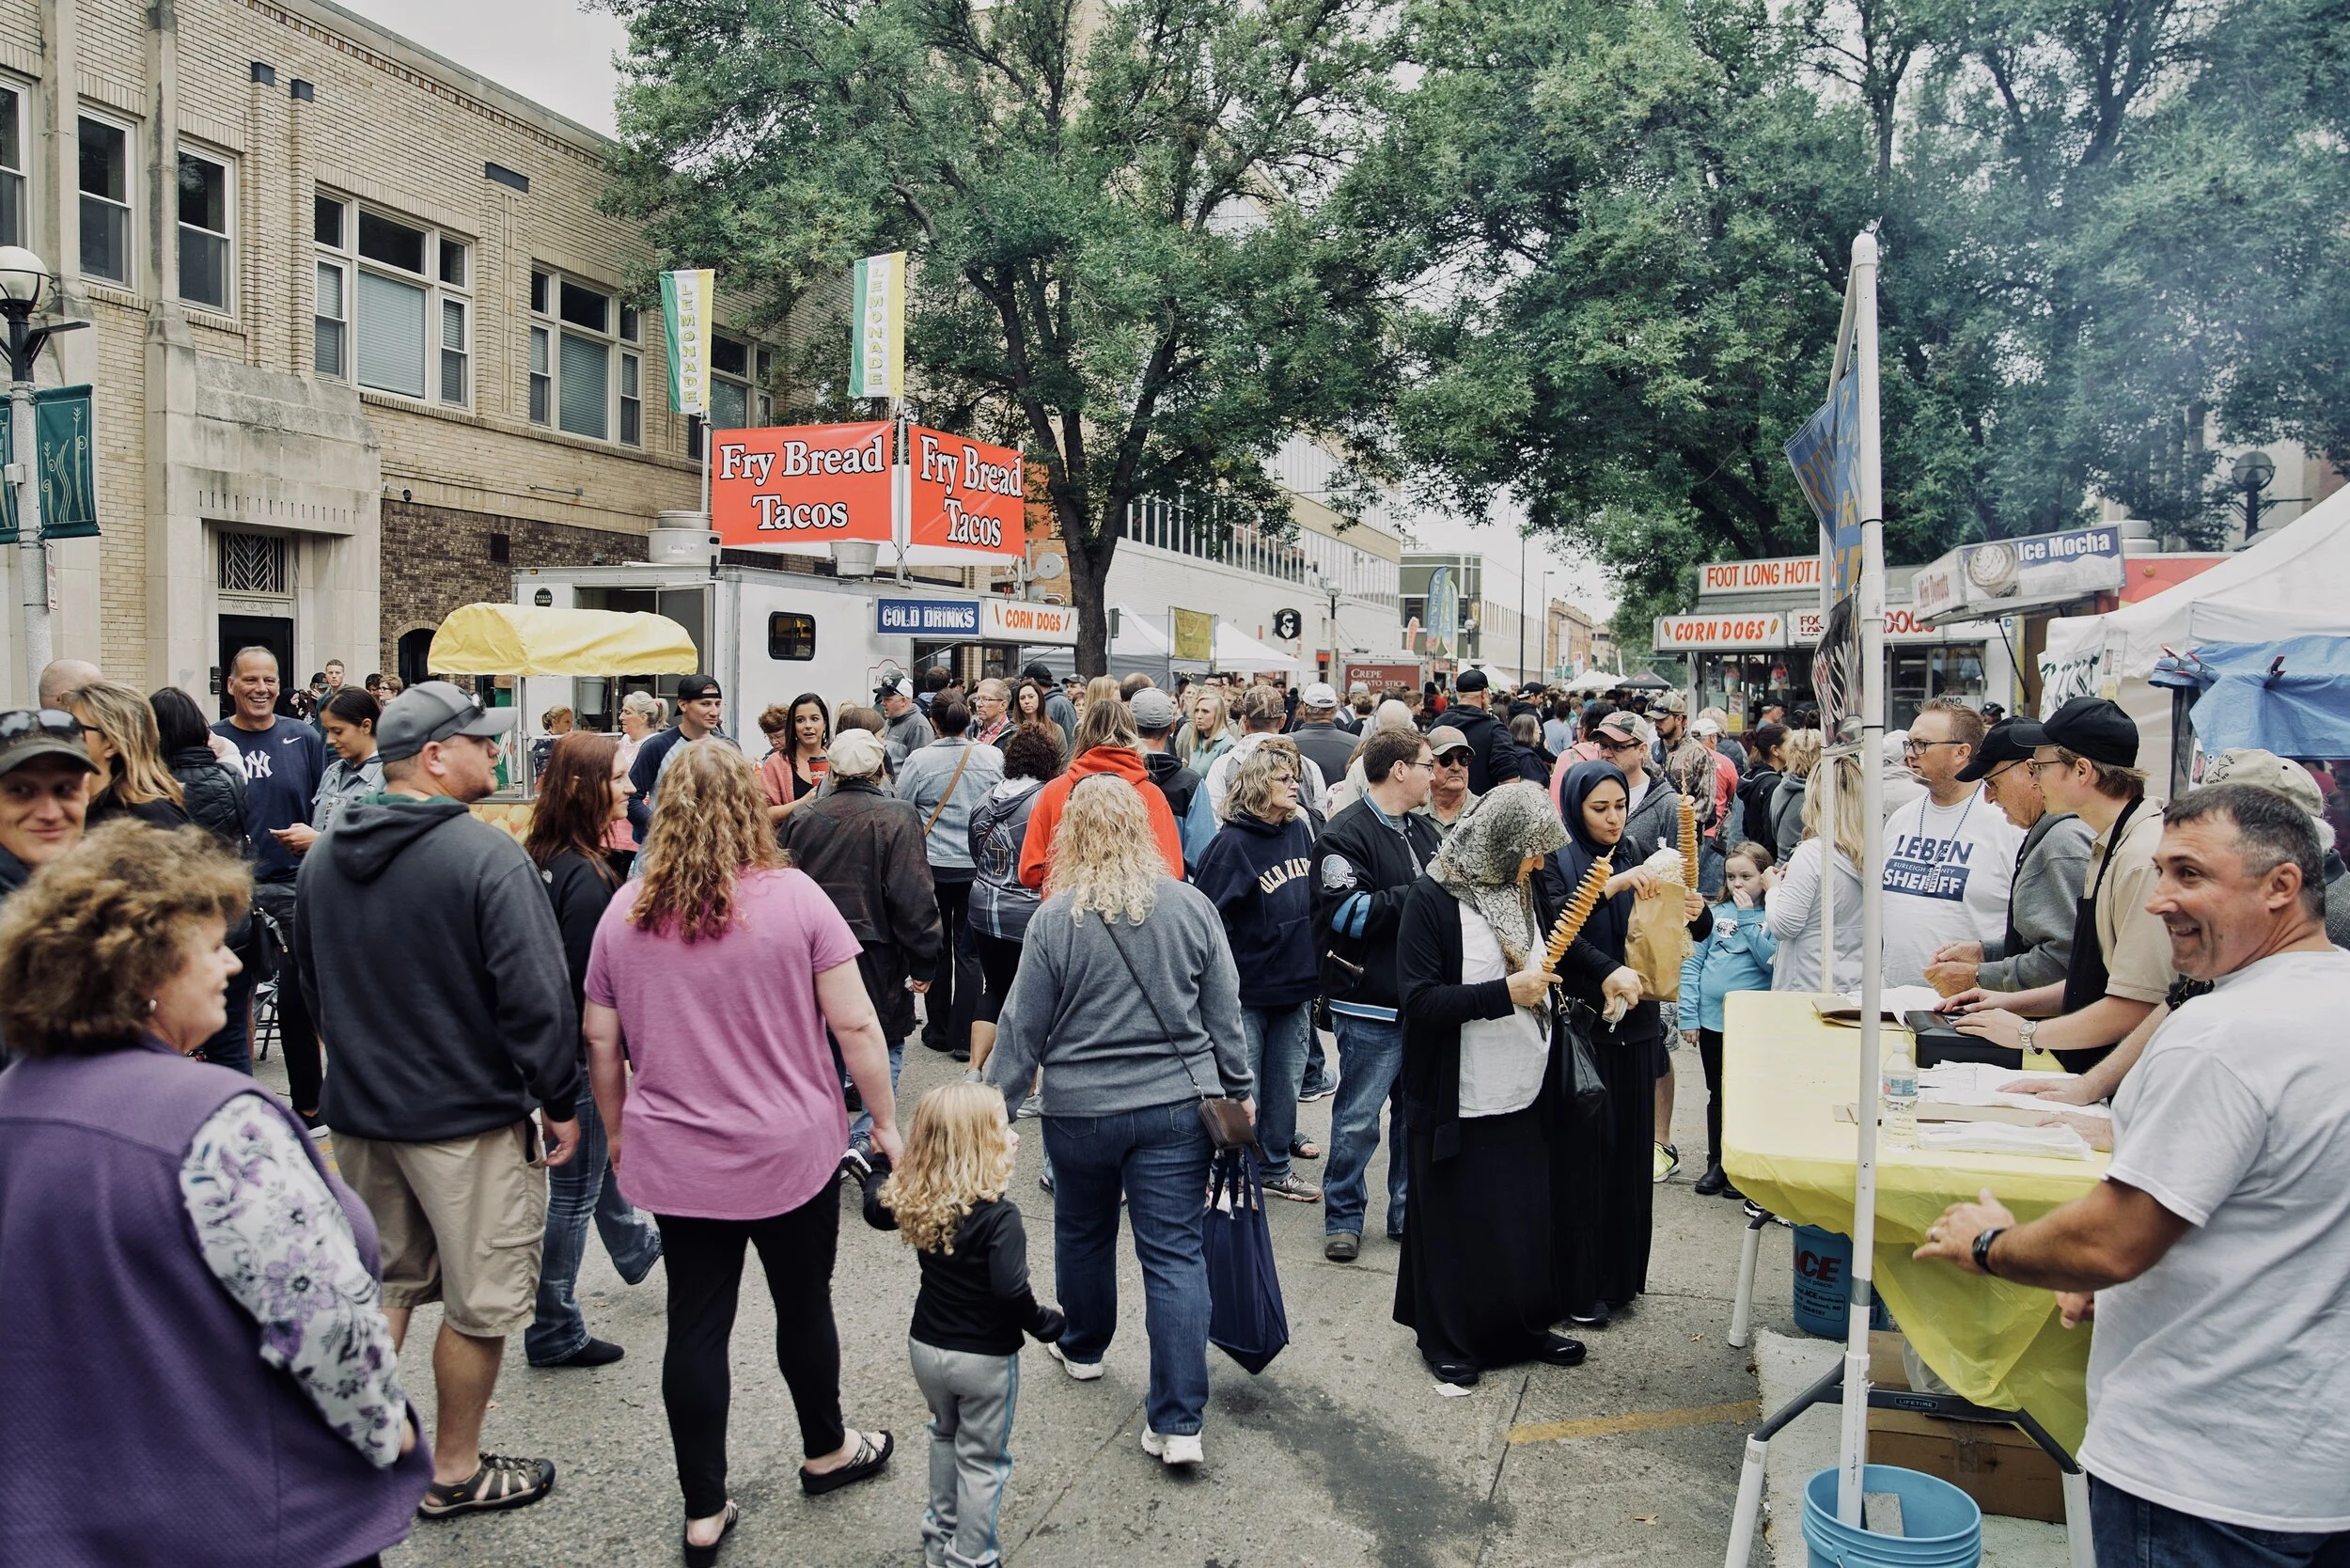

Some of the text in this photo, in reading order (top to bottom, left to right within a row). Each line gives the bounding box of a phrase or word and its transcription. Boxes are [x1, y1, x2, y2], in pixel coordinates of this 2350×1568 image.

[868, 267, 883, 385] LEMONADE
[681, 284, 697, 403] LEMONADE
[719, 434, 885, 487] Fry Bread
[919, 433, 1024, 497] Fry Bread
[751, 494, 849, 531] Tacos
[943, 496, 1002, 547] Tacos
[2017, 531, 2110, 562] Ice Mocha
[1707, 566, 1739, 588] FOOT
[1744, 562, 1779, 587] LONG
[1784, 560, 1813, 585] HOT
[882, 605, 976, 629] COLD DRINKS
[1005, 608, 1061, 633] CORN DOGS
[1675, 619, 1765, 642] CORN DOGS
[1350, 668, 1383, 679] CREPE
[244, 749, 274, 779] NY
[1893, 835, 1974, 865] LEBEN
[1259, 857, 1312, 894] OLD NAV
[1893, 862, 1926, 872] BURLEIGH
[1804, 1289, 1818, 1300] ACE
[1899, 1399, 1933, 1407] LIFETIME
